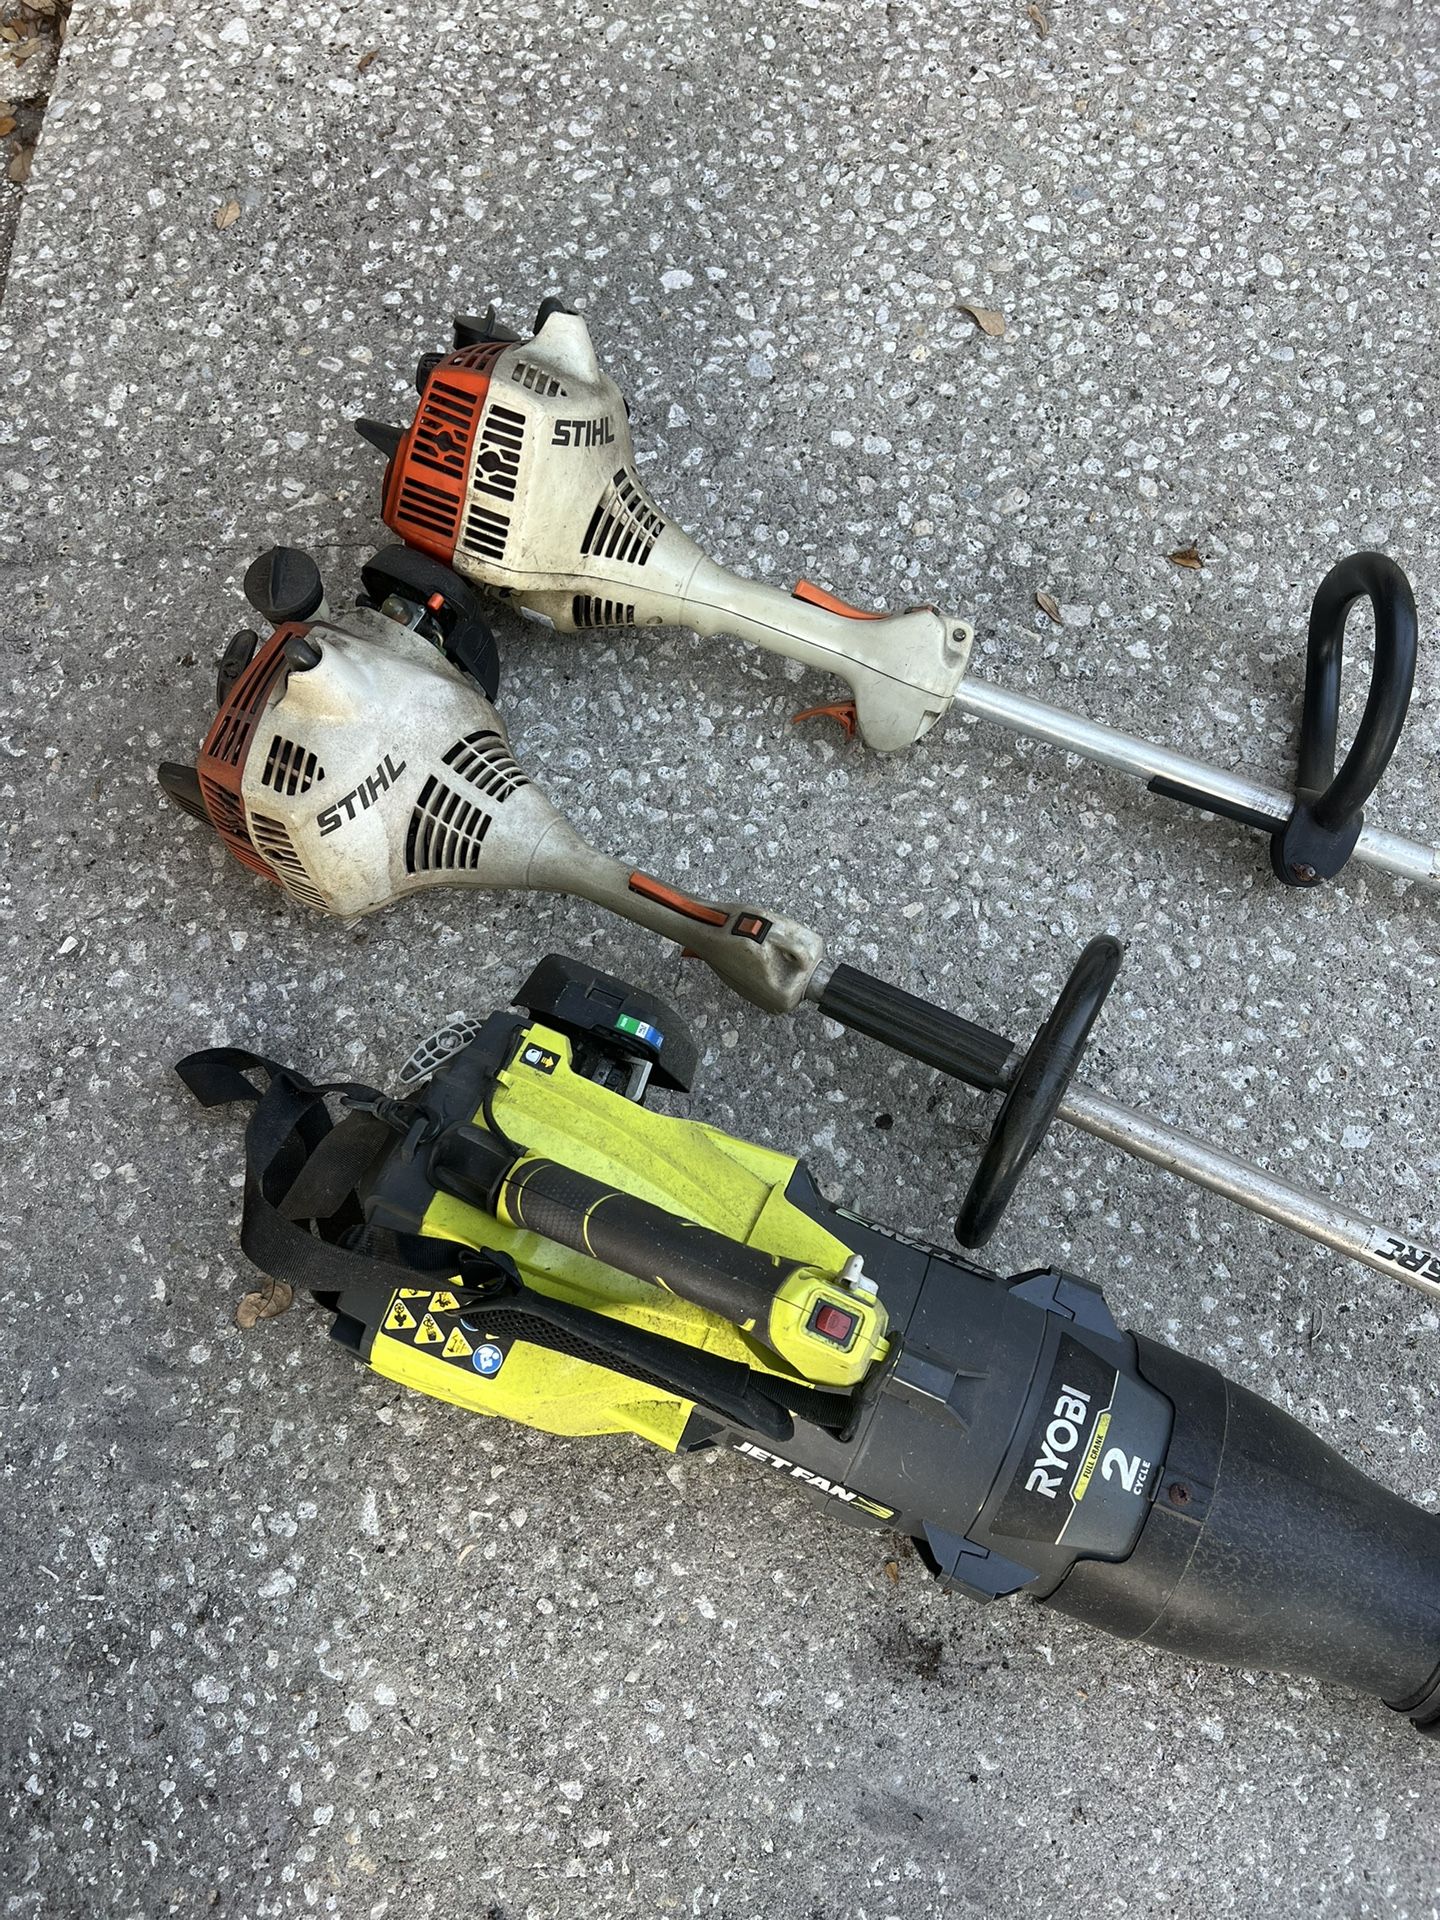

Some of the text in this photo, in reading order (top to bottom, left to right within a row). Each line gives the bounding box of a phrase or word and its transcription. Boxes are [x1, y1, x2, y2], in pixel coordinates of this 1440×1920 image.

[551, 417, 614, 447] STIHL
[316, 754, 406, 837] STIHL
[1025, 1384, 1091, 1498] RYOBI
[1083, 1433, 1104, 1479] FULL CRANK
[732, 1441, 857, 1502] JET FAN
[1101, 1447, 1141, 1492] 2
[1133, 1460, 1151, 1496] CYCLE
